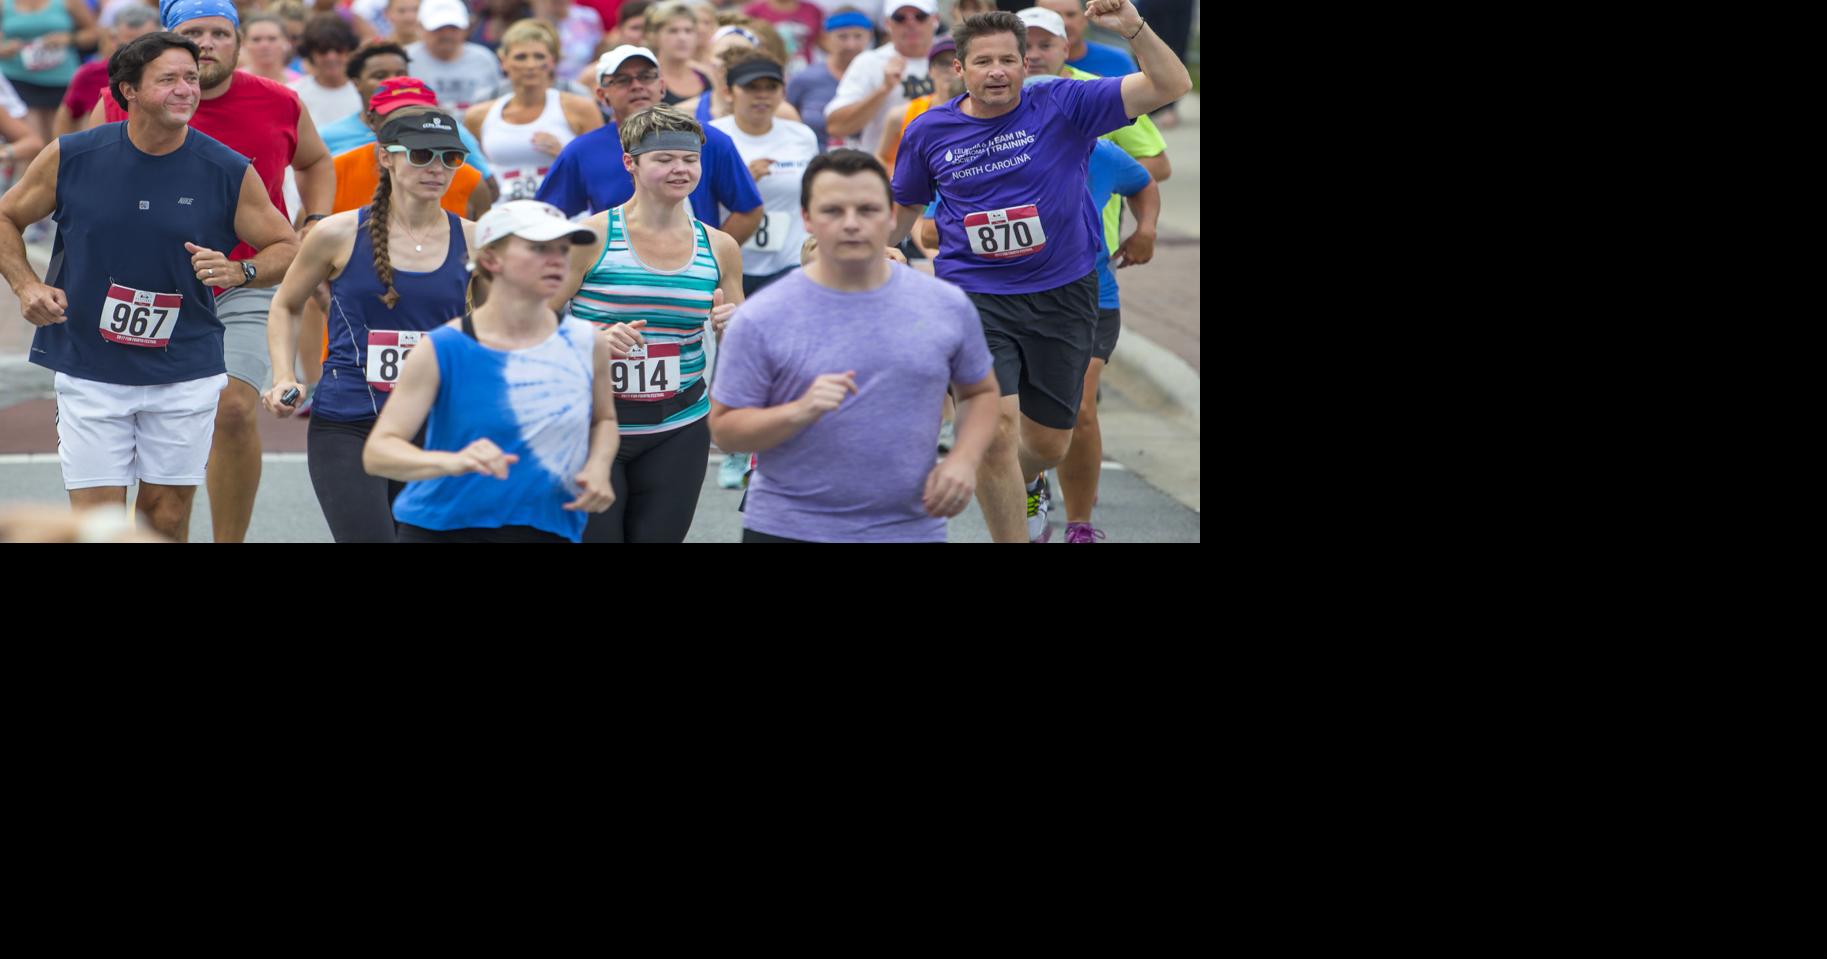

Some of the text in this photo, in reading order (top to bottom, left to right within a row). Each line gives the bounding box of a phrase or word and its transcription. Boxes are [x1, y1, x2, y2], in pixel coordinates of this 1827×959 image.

[991, 135, 1034, 152] TRAINING
[1015, 129, 1026, 139] IN
[952, 153, 1031, 180] NORTH CAROLINA
[978, 221, 1033, 253] 870
[110, 303, 169, 338] 967
[611, 359, 668, 393] 914
